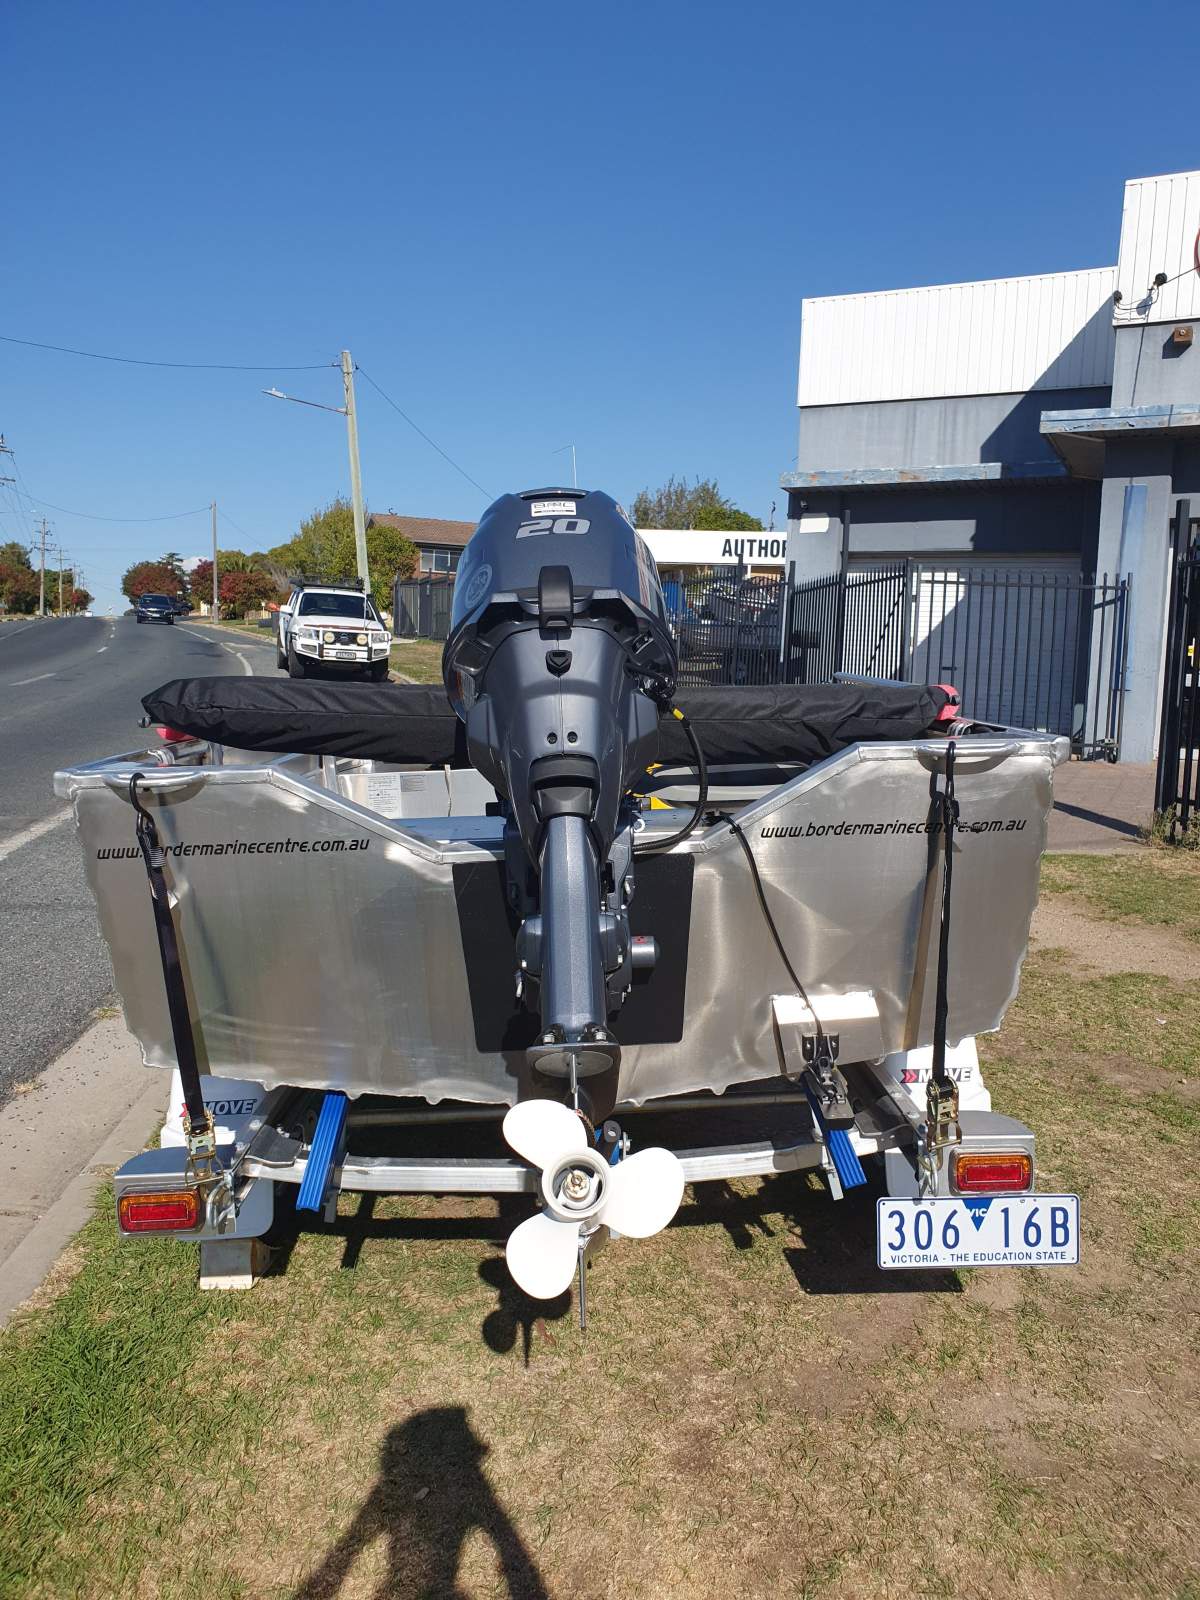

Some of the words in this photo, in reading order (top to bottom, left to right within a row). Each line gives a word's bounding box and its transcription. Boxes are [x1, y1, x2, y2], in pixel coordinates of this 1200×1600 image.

[515, 518, 591, 539] 20
[96, 837, 370, 860] www.rdermarinecentre.com.au
[918, 1067, 973, 1083] MVE
[967, 1207, 989, 1218] VIC
[887, 1209, 961, 1251] 306
[1000, 1206, 1070, 1248] 16B
[890, 1253, 939, 1264] VICTORIA
[950, 1252, 970, 1262] THE
[973, 1251, 1034, 1262] EDUCATION
[1036, 1251, 1067, 1261] STATE
